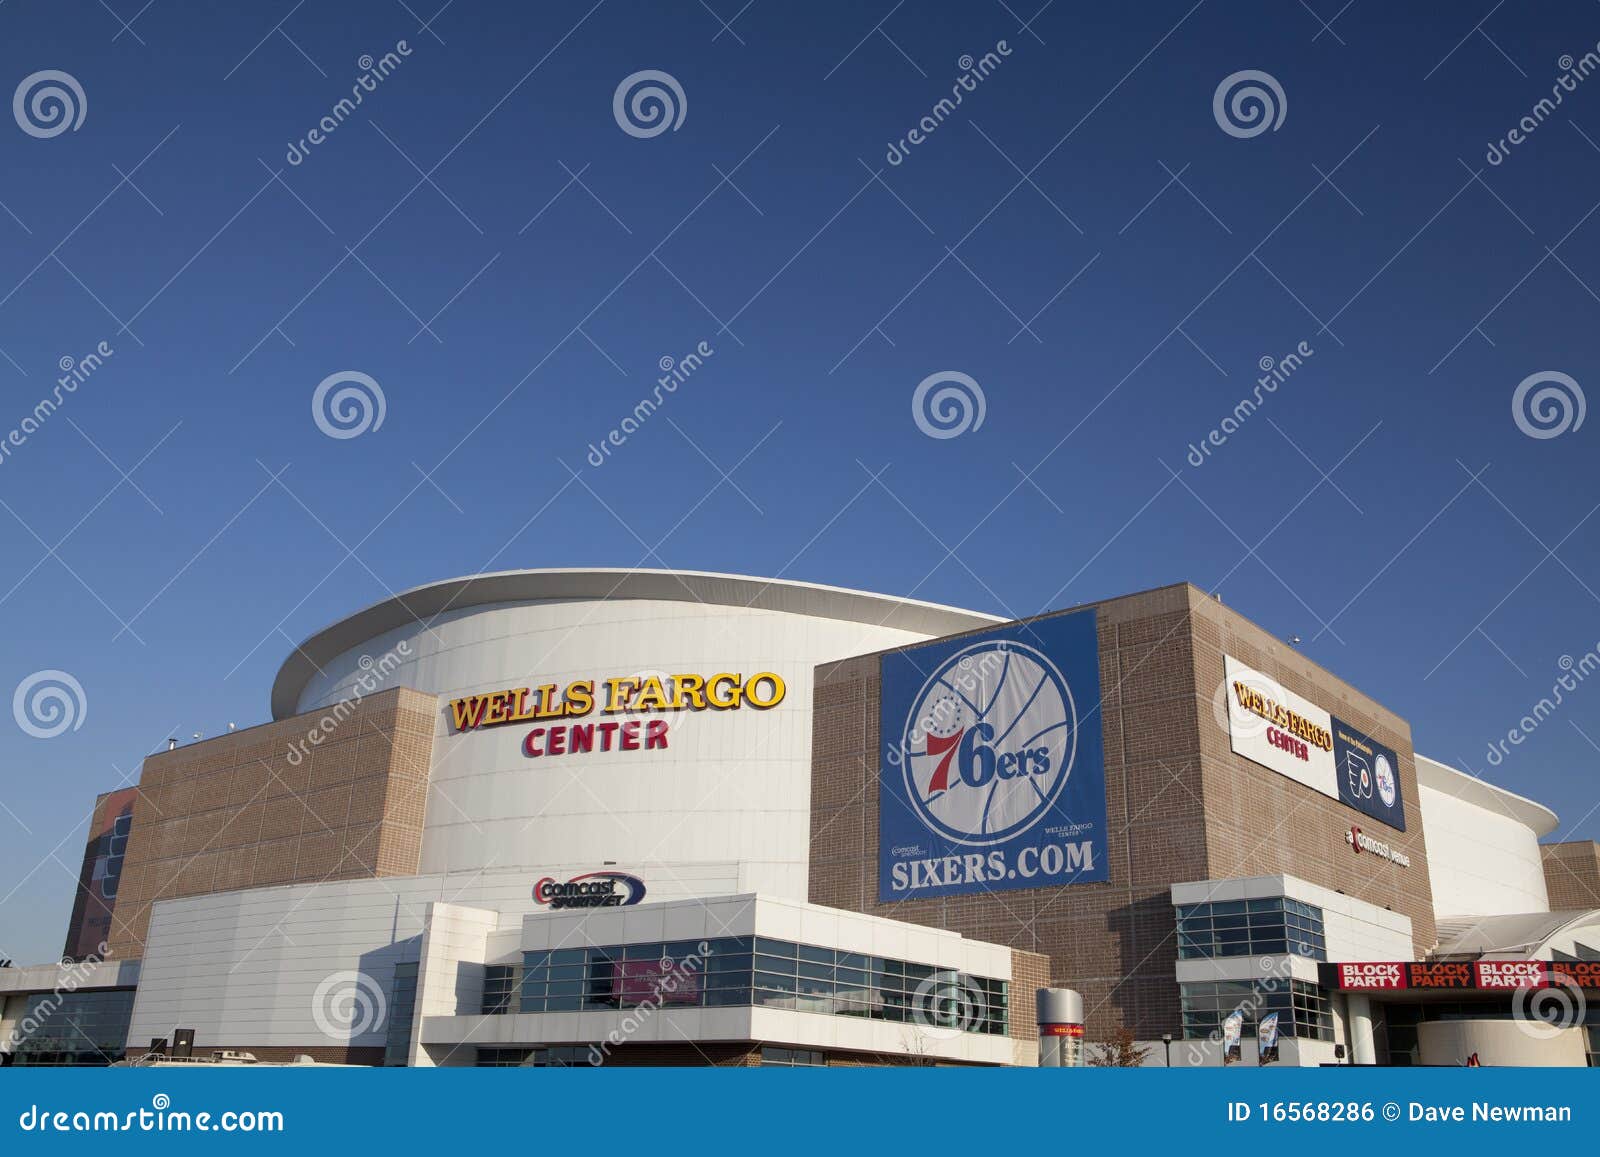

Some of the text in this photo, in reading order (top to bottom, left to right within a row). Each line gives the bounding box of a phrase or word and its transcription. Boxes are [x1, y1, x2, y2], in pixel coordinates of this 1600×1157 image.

[449, 672, 787, 732] WELLS FARGO
[1233, 681, 1289, 728] WELLS
[1288, 712, 1333, 753] FARGO
[523, 720, 669, 757] CENTER
[926, 722, 1051, 795] 76ers
[1267, 726, 1309, 762] CENTER
[892, 840, 1095, 891] SIXERS.COM
[1342, 963, 1600, 976] BLOCK BLOCK BLOCK BLOC
[1343, 975, 1600, 987] PARTY PARTY PARTY PART
